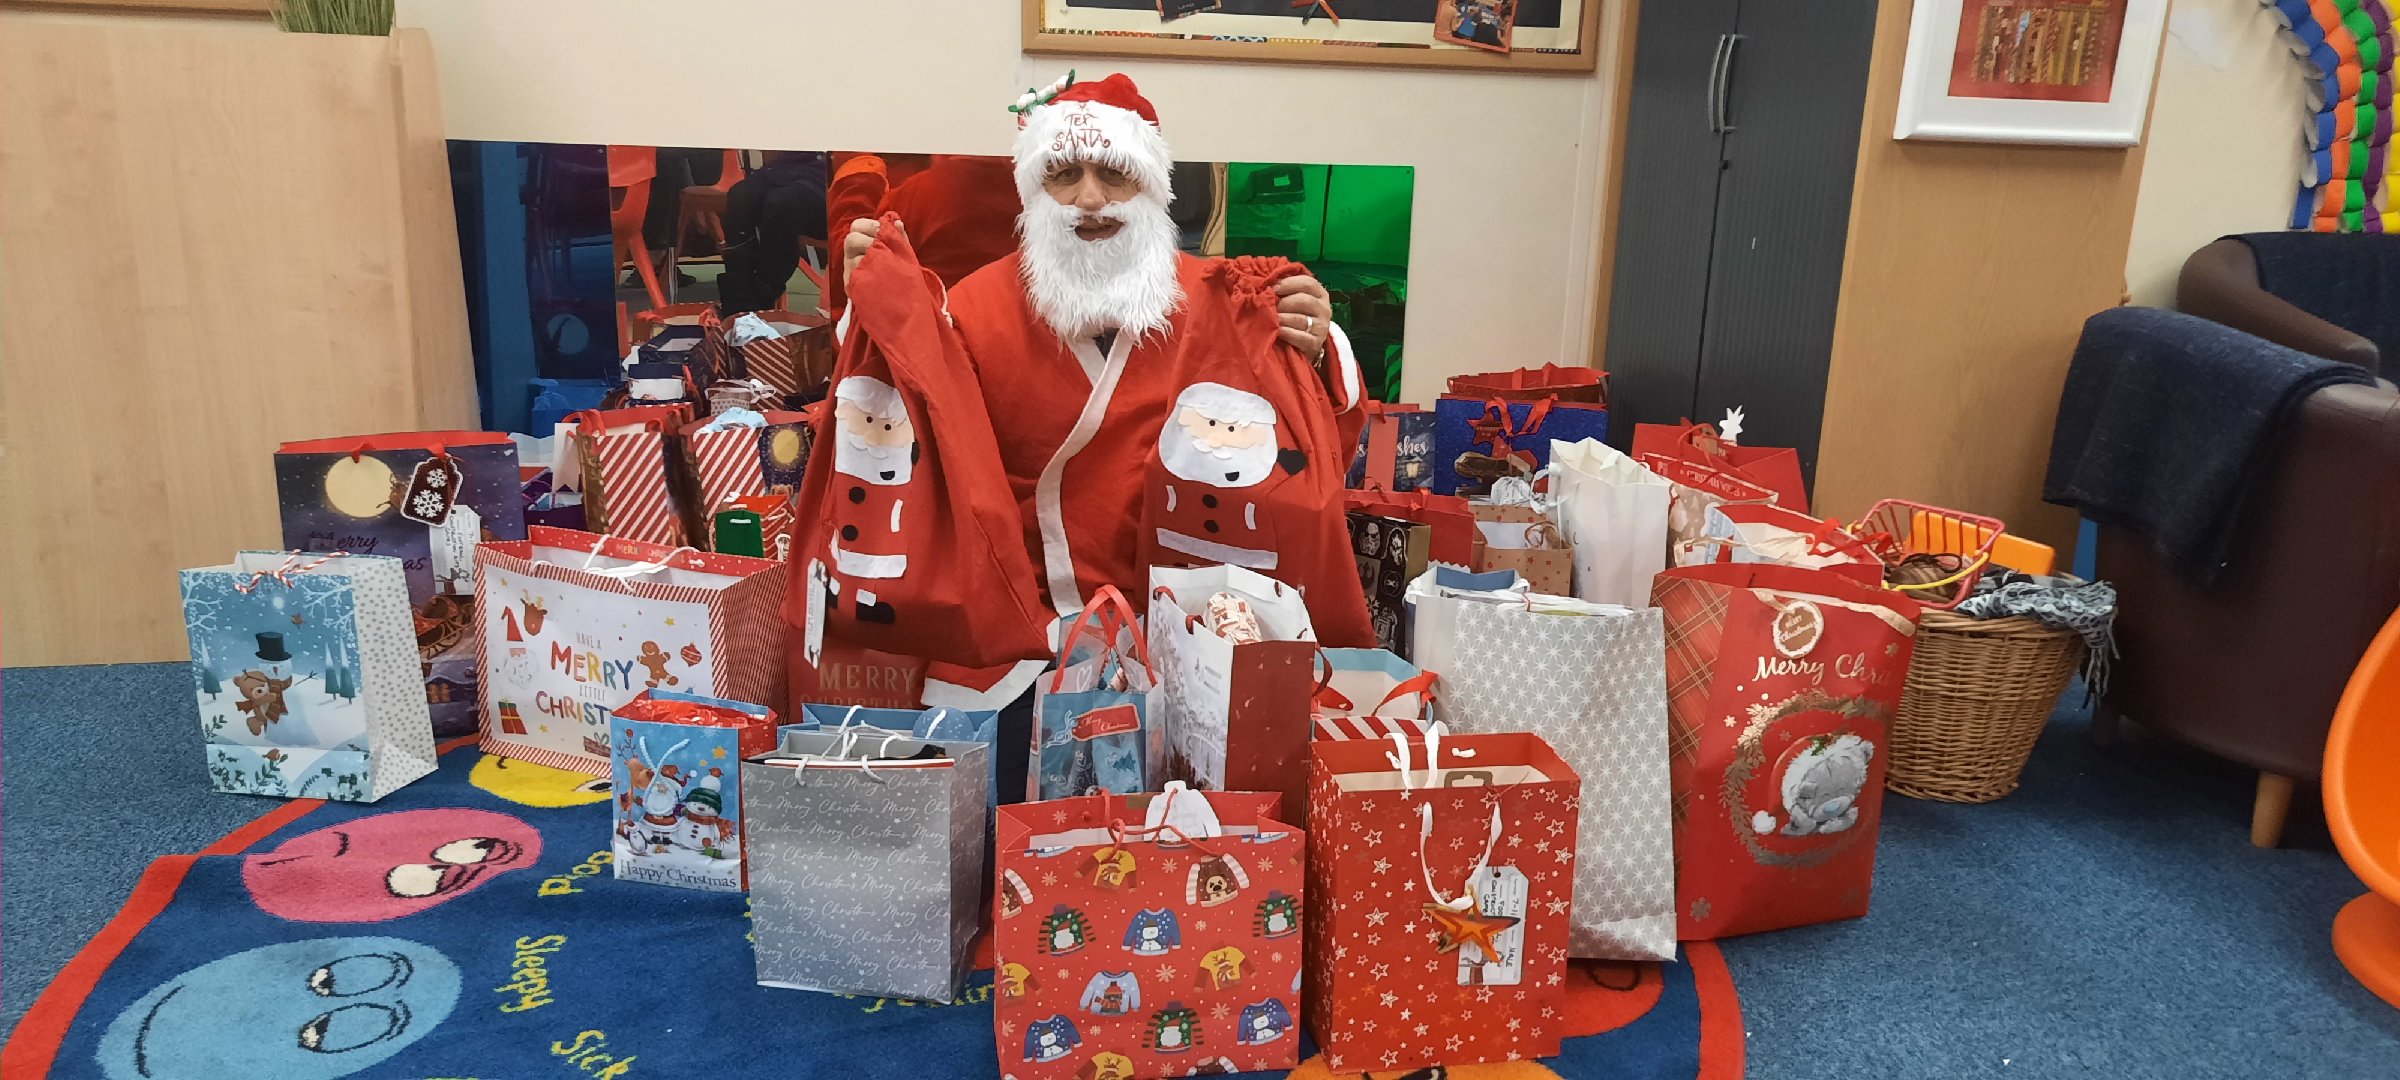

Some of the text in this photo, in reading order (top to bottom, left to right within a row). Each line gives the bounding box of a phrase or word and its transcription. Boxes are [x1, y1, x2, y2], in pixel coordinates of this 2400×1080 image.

[1051, 127, 1112, 152] SANTA
[576, 632, 595, 645] HAVE
[551, 640, 634, 691] MERRY
[819, 662, 918, 695] MERRY
[1751, 656, 1825, 685] Merry
[535, 690, 613, 725] CHRIST
[776, 796, 811, 818] Merry
[881, 798, 916, 820] Merry
[809, 821, 843, 843] Merry
[912, 824, 945, 844] Merry
[844, 847, 880, 871] Merry
[620, 859, 737, 888] Happy Christmas
[862, 874, 895, 899] Merry
[883, 902, 918, 926] Merry
[813, 924, 846, 947] Merry
[910, 929, 944, 951] Merry
[493, 934, 568, 1012] Sleepy
[847, 951, 879, 975] Merry
[552, 1030, 638, 1080] Sick
